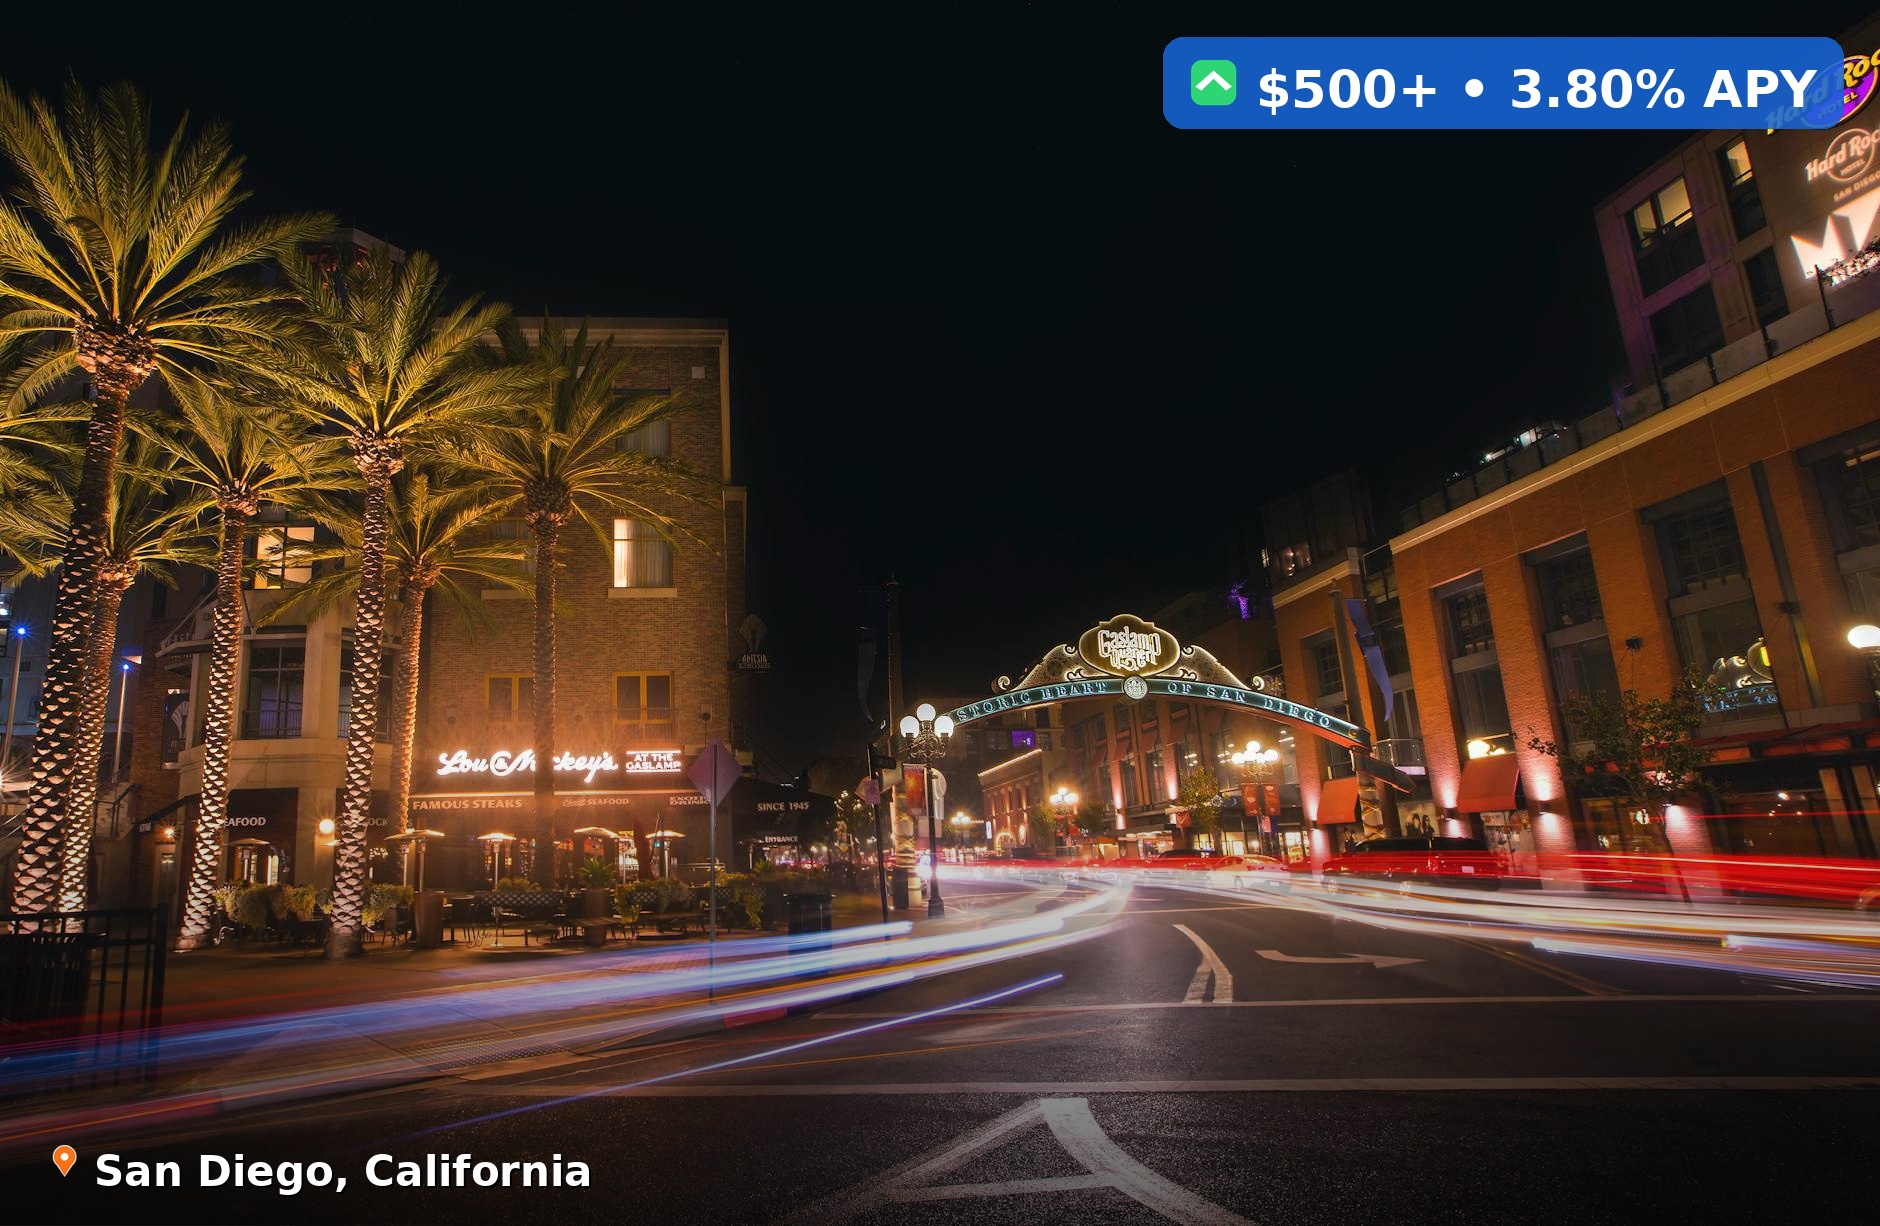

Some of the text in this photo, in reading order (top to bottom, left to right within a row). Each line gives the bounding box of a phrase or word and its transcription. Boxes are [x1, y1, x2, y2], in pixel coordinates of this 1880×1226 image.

[1834, 47, 1880, 92] Roc
[1805, 128, 1880, 181] Hard Roc
[1098, 626, 1161, 657] Gaslamp
[956, 682, 1331, 728] STORIC HEART OF SAN DIEGO
[634, 753, 673, 761] AT THE
[437, 750, 488, 776] Lou
[490, 749, 619, 783] Mckey's
[625, 761, 681, 770] GASLAMP
[413, 799, 522, 810] FAMOUS STEAKS
[587, 798, 630, 806] SEAFOOD
[757, 802, 809, 811] SINCE 1945
[224, 816, 267, 827] EAFOOD
